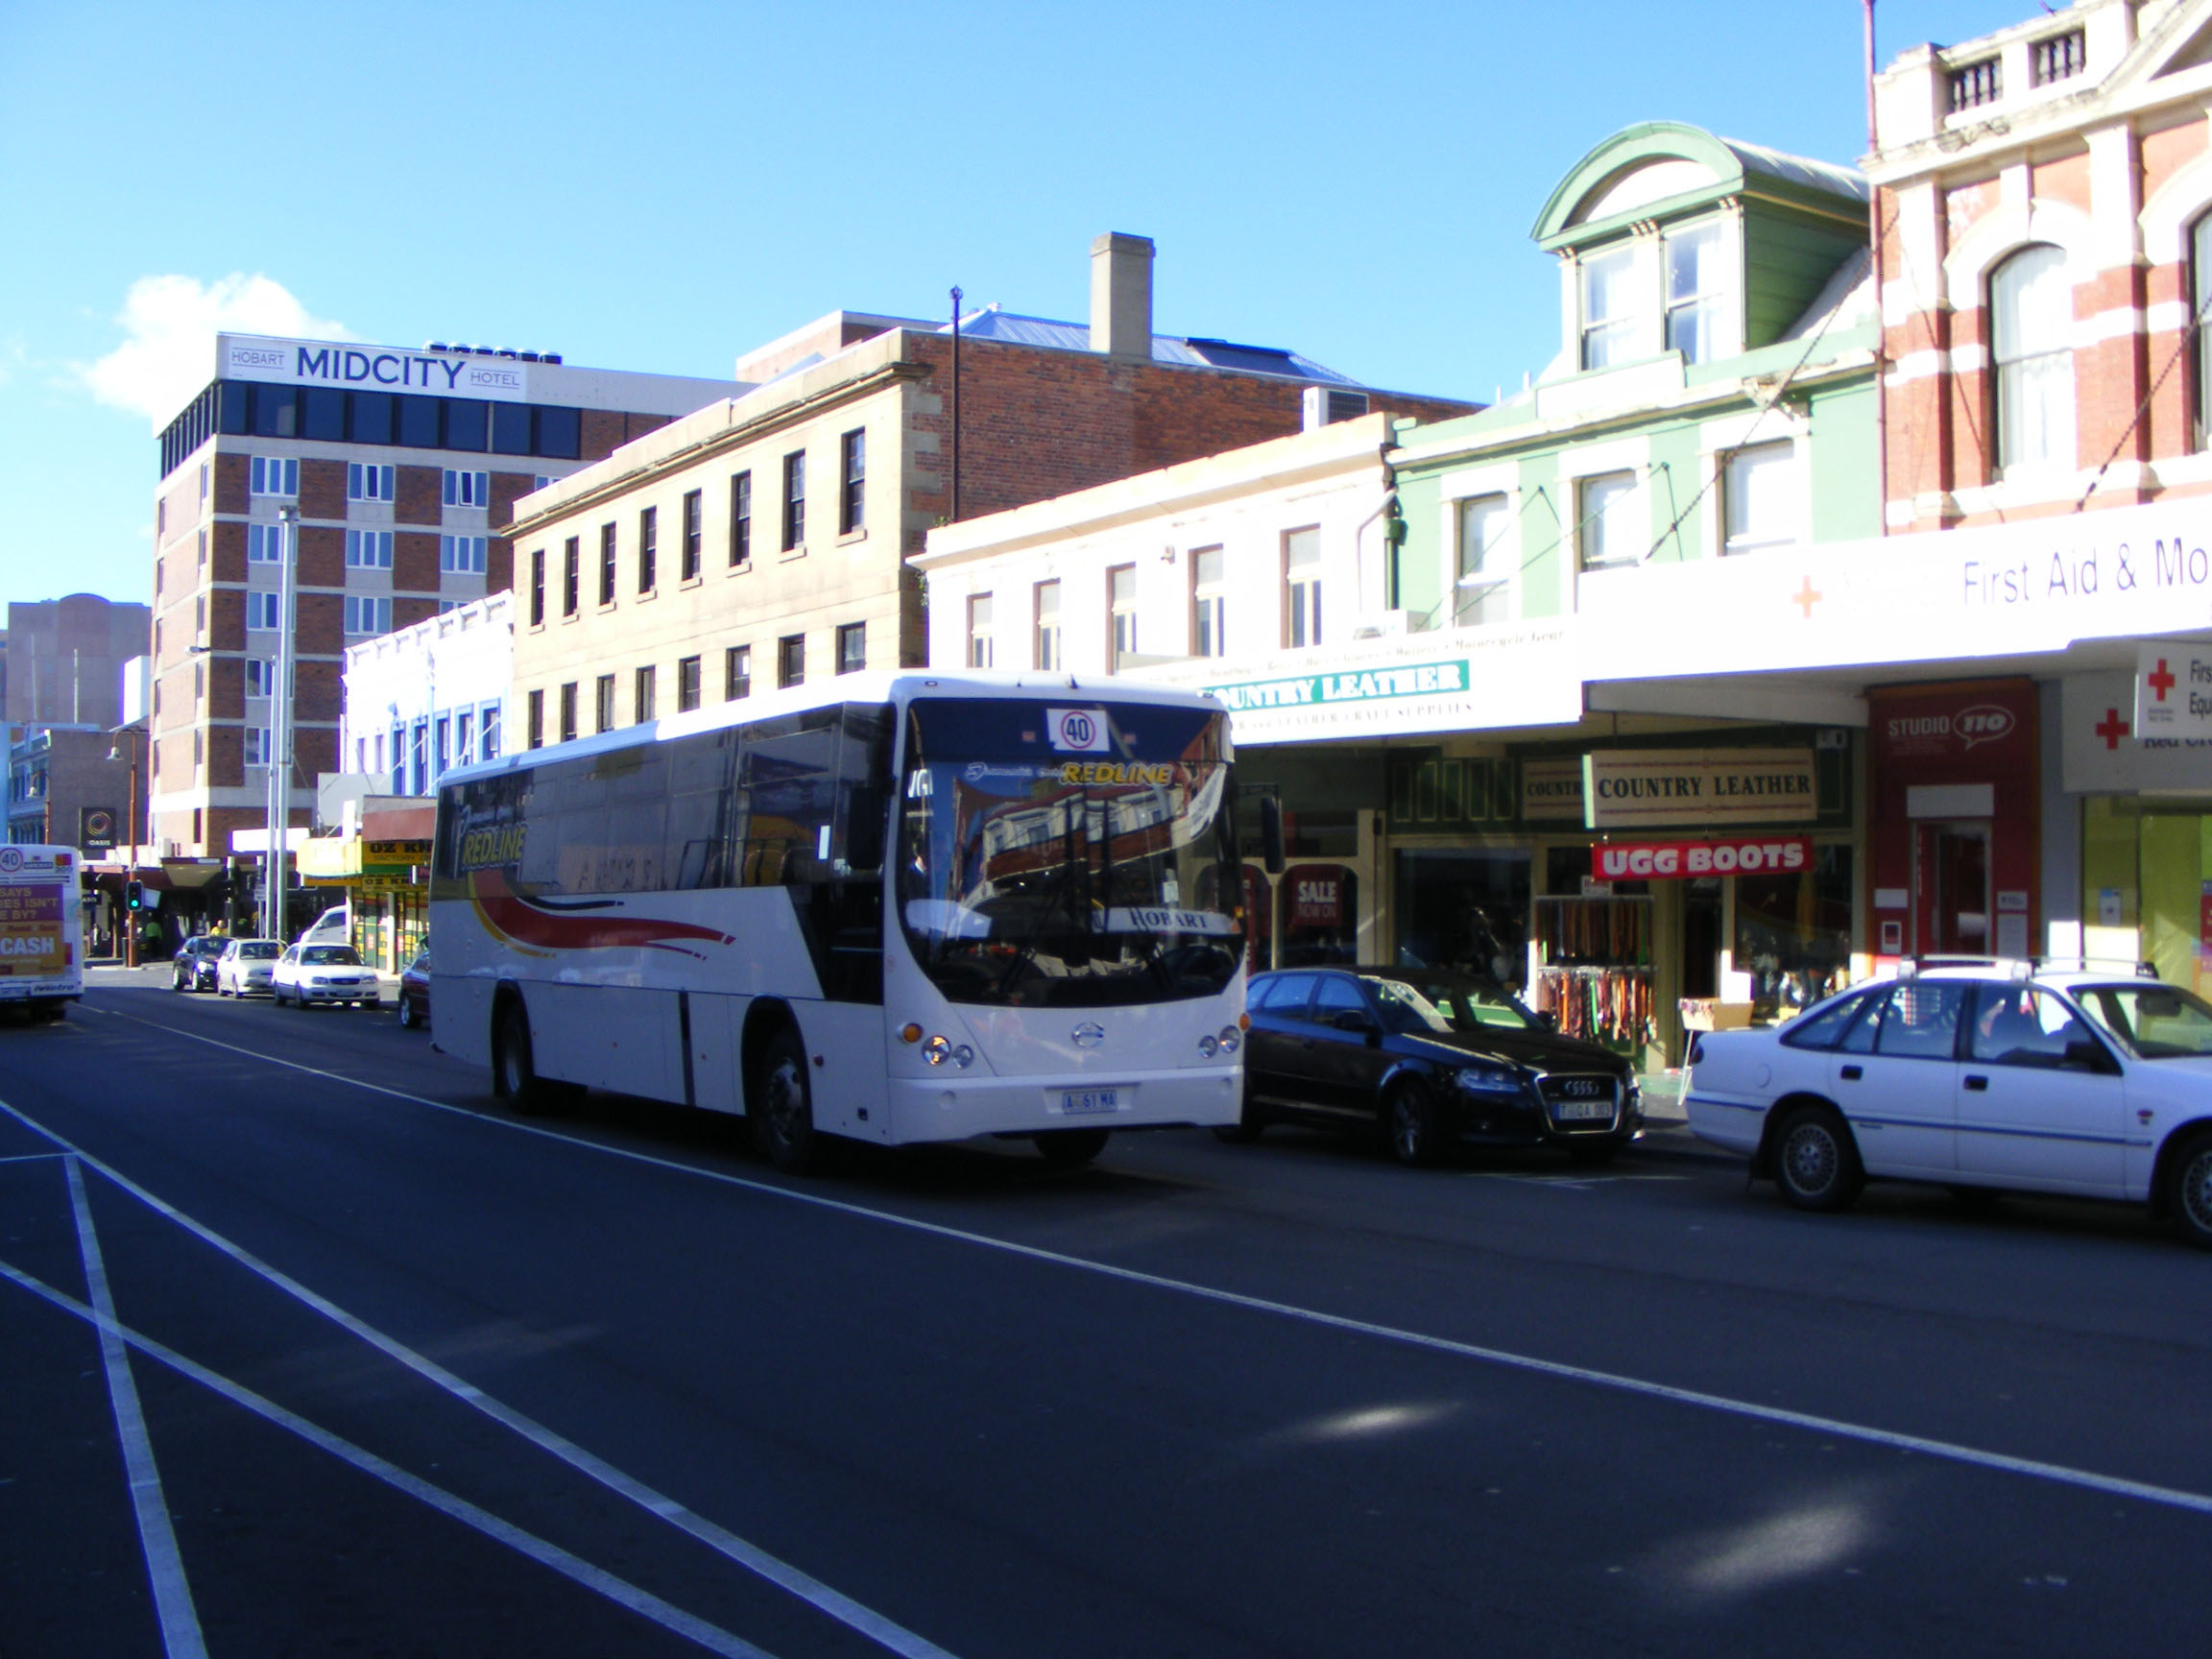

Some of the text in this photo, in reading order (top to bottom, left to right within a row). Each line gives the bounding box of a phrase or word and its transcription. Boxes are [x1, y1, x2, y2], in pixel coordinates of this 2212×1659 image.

[231, 349, 285, 366] HOBART
[297, 347, 466, 390] MIDCITY
[470, 371, 520, 386] HOTEL
[1964, 560, 2030, 606] First
[2047, 546, 2098, 596] Aid
[2116, 542, 2137, 591] &
[1321, 663, 1462, 701] LEATHER
[1066, 718, 1090, 742] 40
[1888, 715, 1950, 737] STUDIO
[1059, 762, 1173, 786] REDLINE
[1598, 774, 1812, 799] COUNTRY LEATHER
[462, 826, 527, 865] REDLINE
[2, 853, 19, 866] 40
[1602, 842, 1805, 877] UGG BOOTS
[1297, 880, 1337, 902] SALE
[0, 936, 55, 954] CASH
